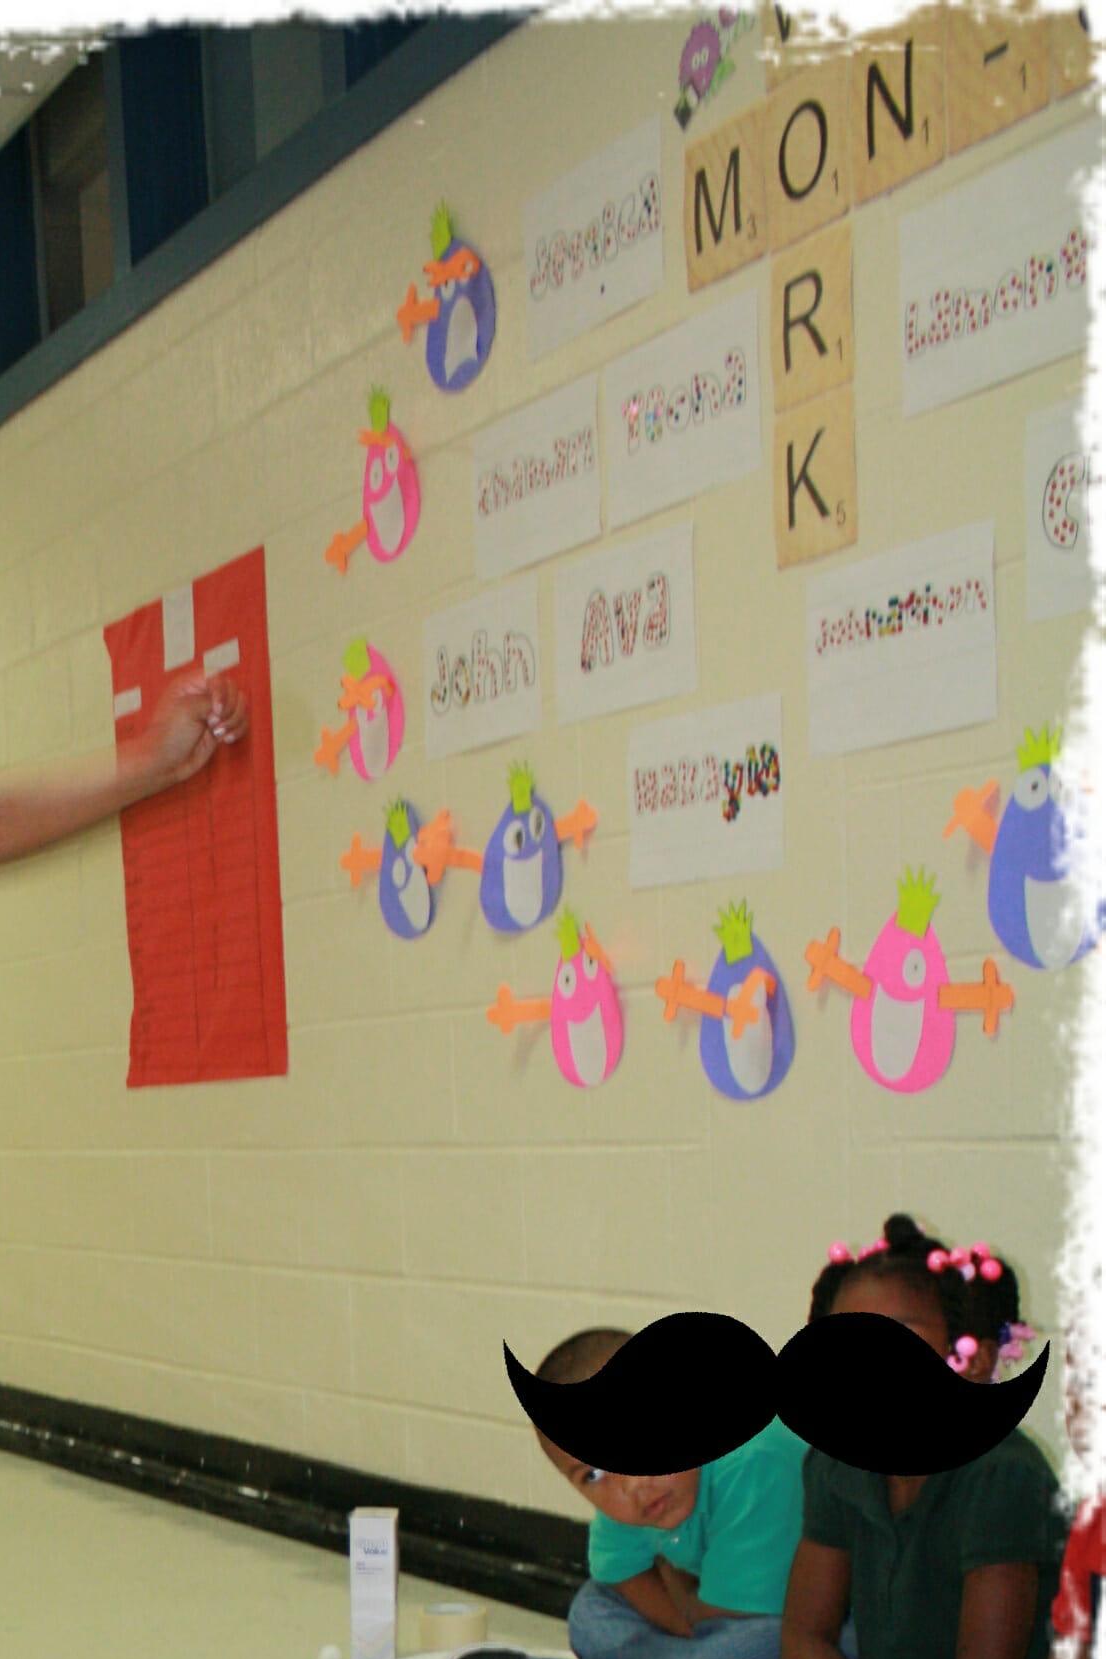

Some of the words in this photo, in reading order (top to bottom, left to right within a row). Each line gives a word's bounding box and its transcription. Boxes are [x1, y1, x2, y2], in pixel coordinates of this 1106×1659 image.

[921, 115, 930, 147] 1
[831, 168, 839, 196] 1
[747, 212, 758, 240] 3
[835, 501, 847, 526] 5
[580, 572, 670, 674] Ava
[431, 629, 535, 717] John
